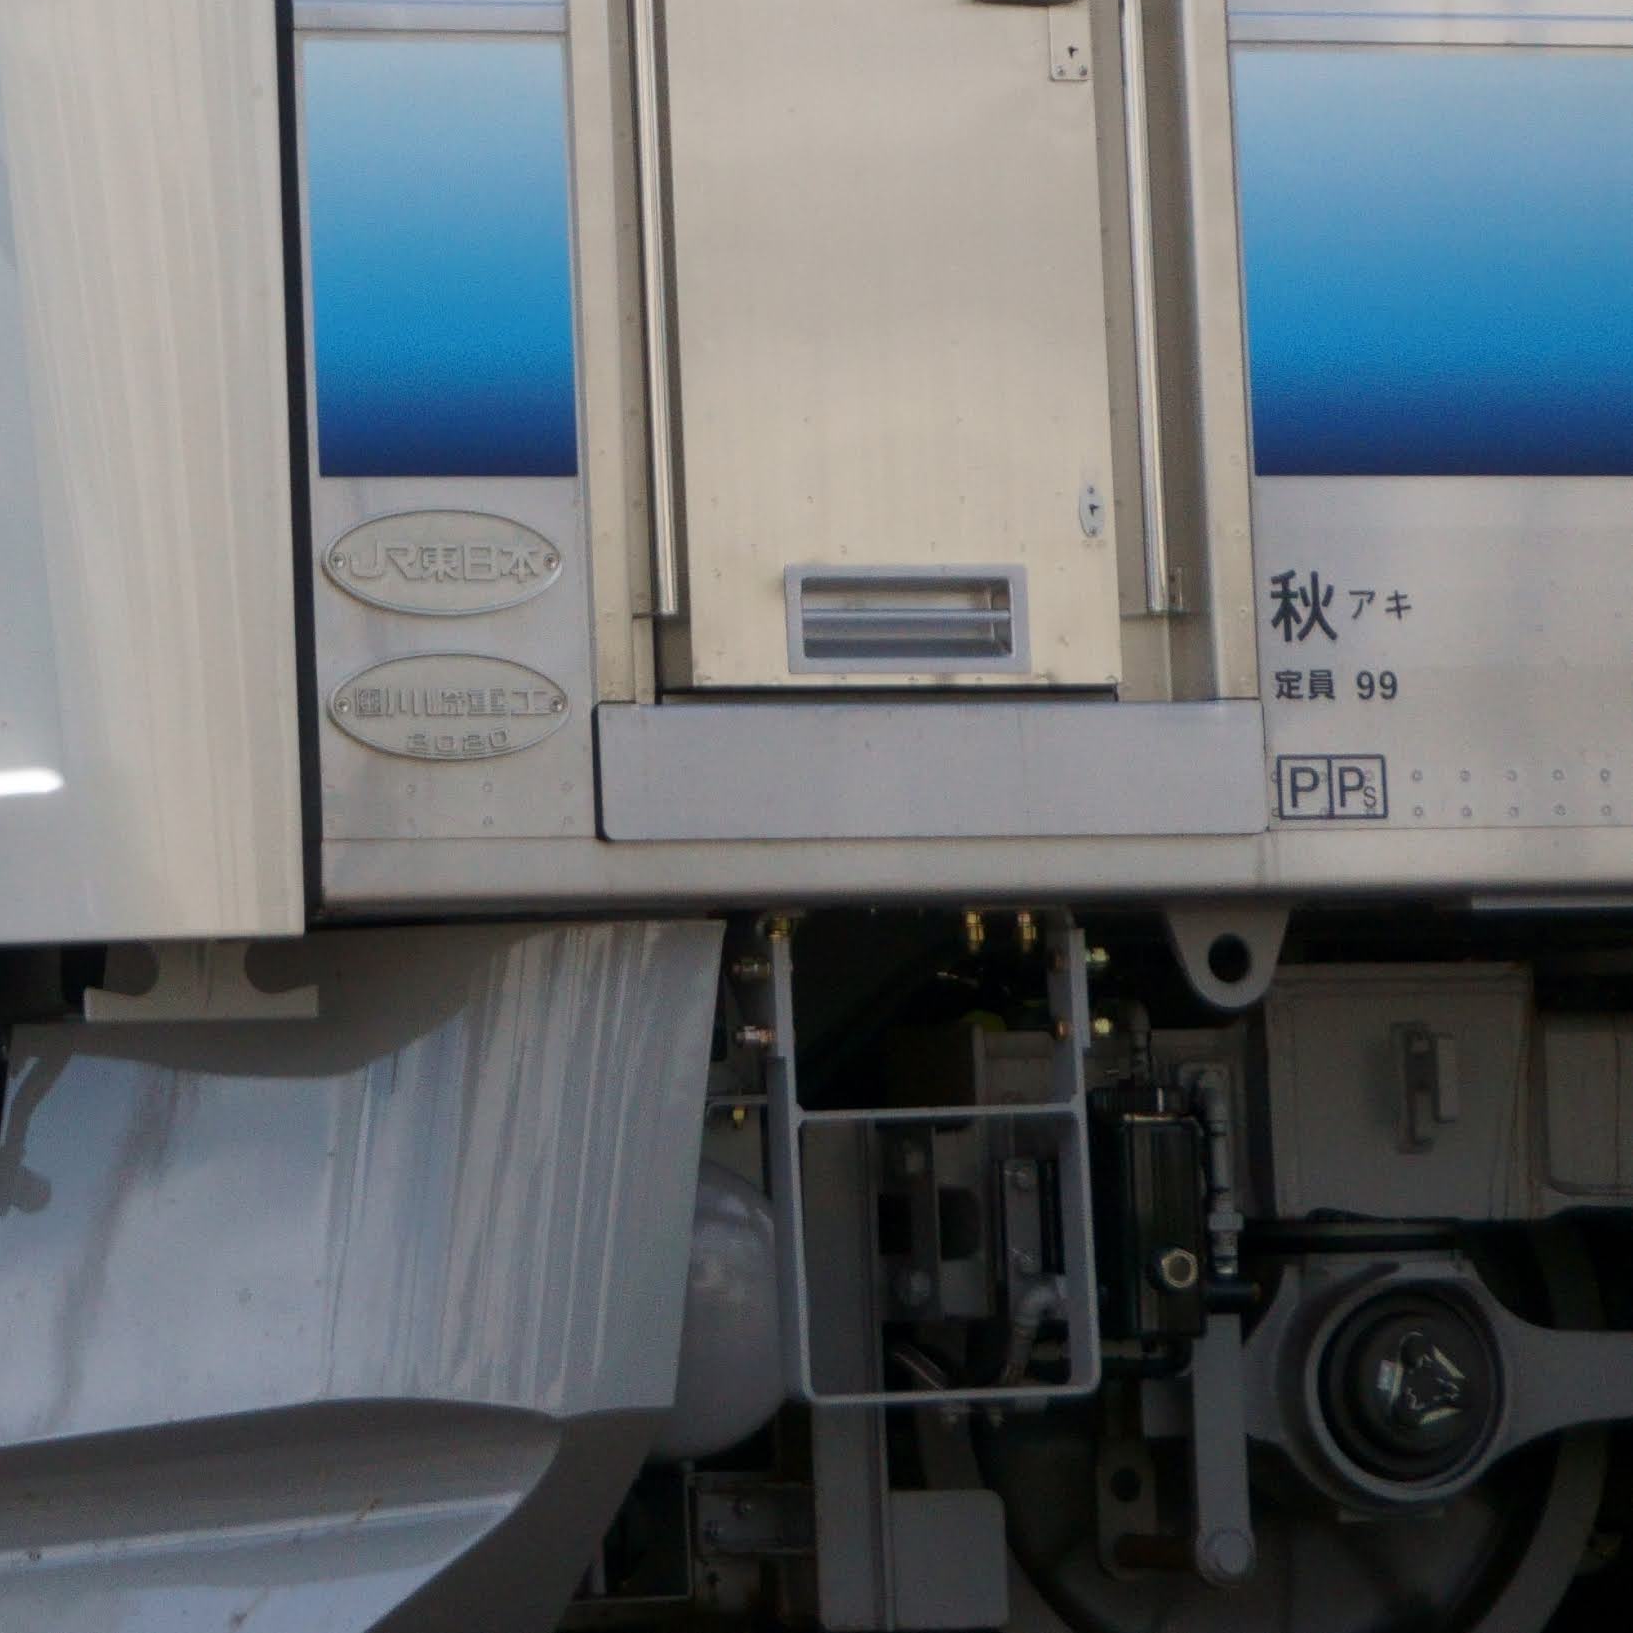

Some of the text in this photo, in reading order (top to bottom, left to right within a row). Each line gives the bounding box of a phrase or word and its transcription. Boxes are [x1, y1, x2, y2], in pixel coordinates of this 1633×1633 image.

[349, 541, 540, 584] JR東日本
[1270, 569, 1412, 643] 秋 アキ
[1275, 670, 1398, 701] 定員 99
